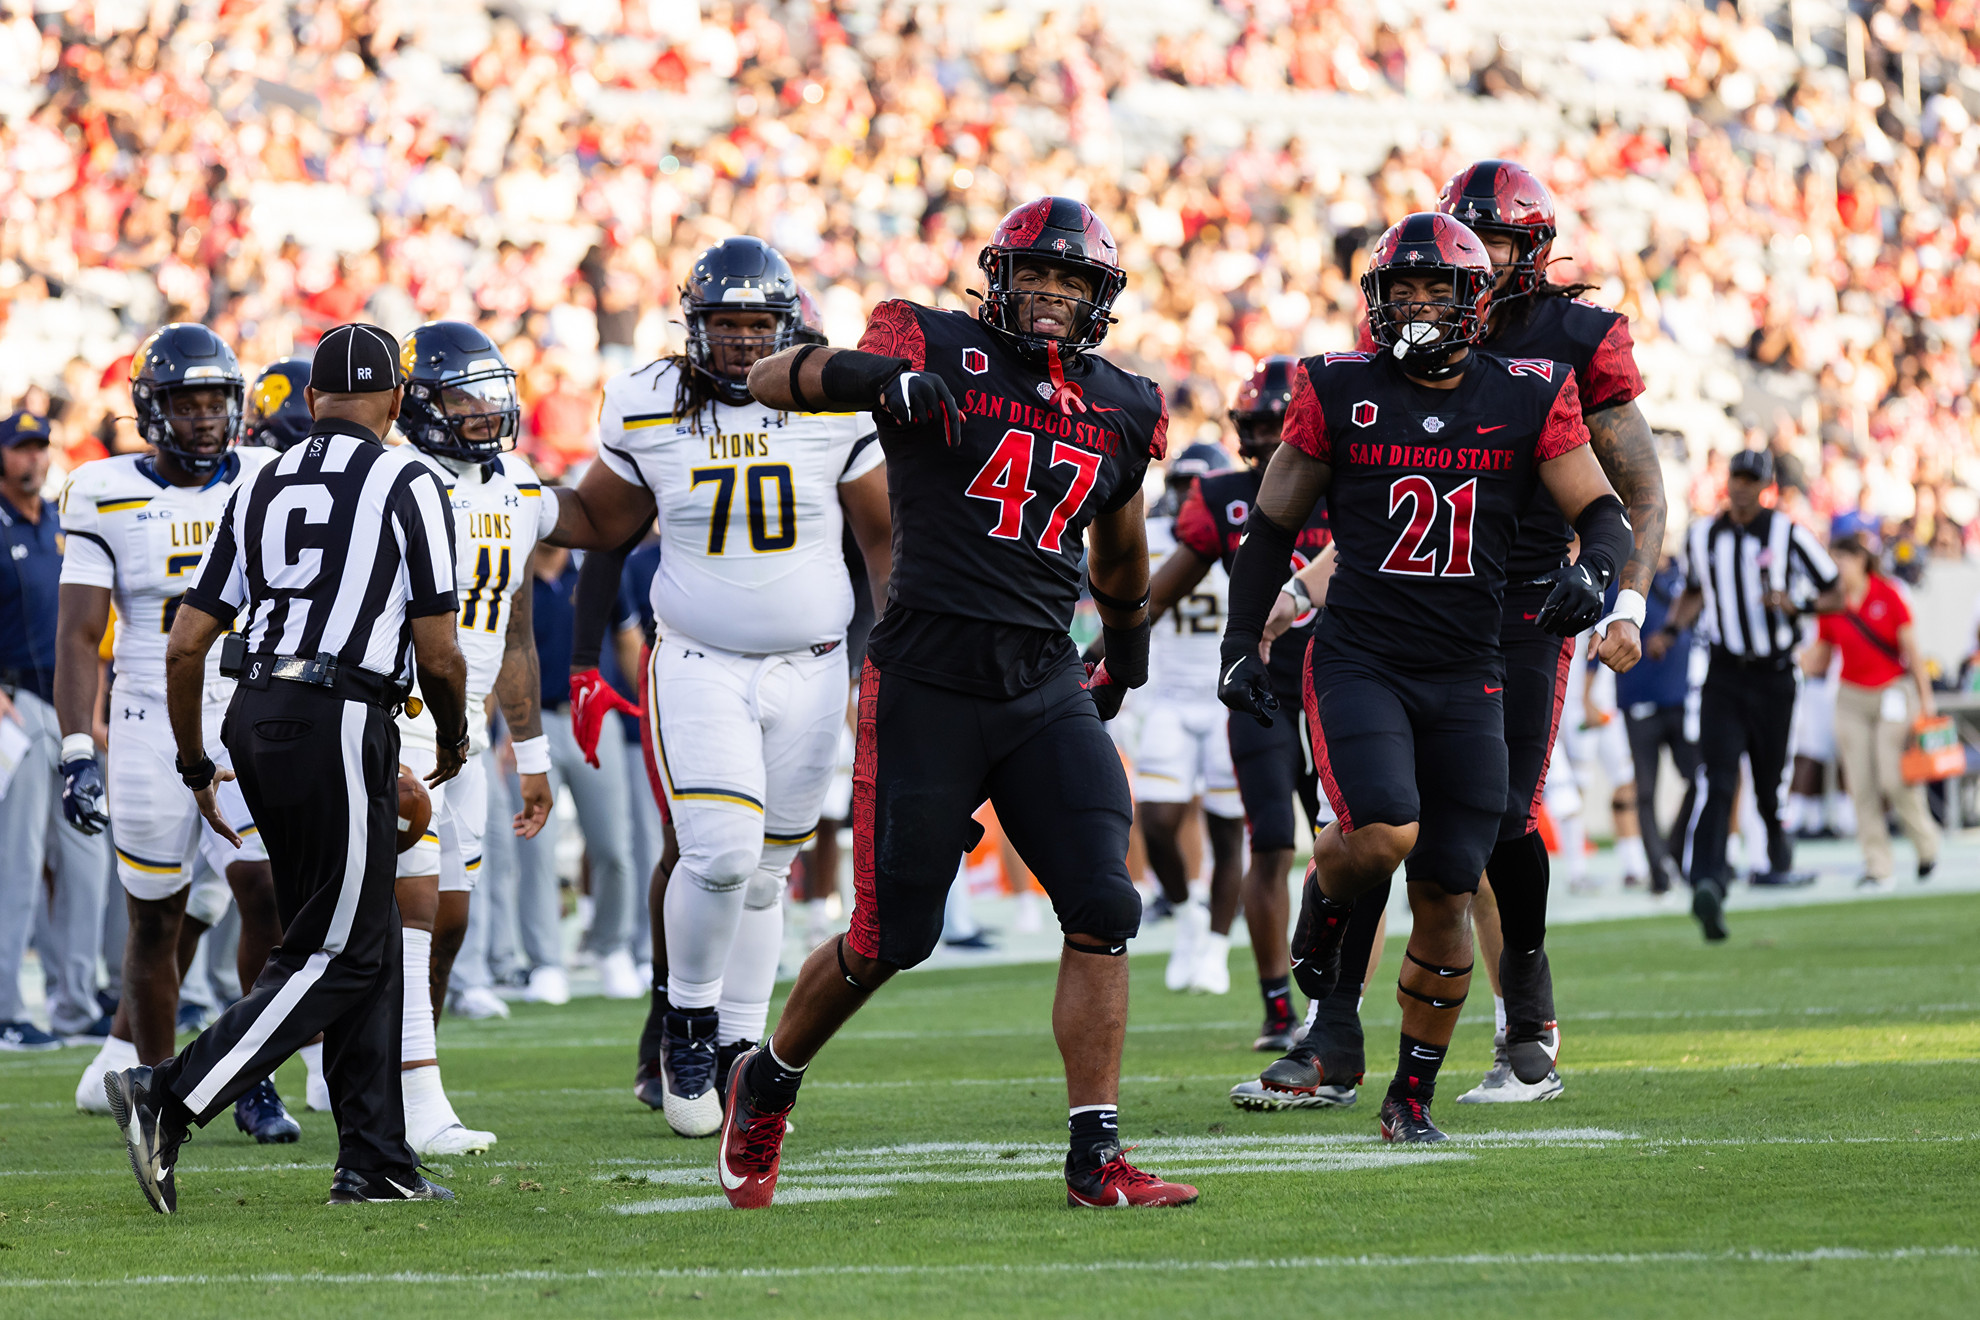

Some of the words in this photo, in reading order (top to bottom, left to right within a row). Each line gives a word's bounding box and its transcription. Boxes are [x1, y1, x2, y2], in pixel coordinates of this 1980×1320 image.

[357, 367, 373, 380] RR
[709, 432, 768, 460] LIONS
[963, 389, 1004, 419] SAN
[1008, 401, 1071, 439] DIEGO
[1075, 420, 1121, 458] STATE
[1350, 443, 1384, 465] SAN
[1388, 445, 1452, 469] DIEGO
[1456, 448, 1514, 470] STATE
[470, 513, 511, 540] LIONS
[690, 462, 797, 556] 70
[965, 428, 1102, 555] 47
[1378, 474, 1478, 577] 21
[261, 484, 335, 590] C
[459, 544, 511, 634] 11
